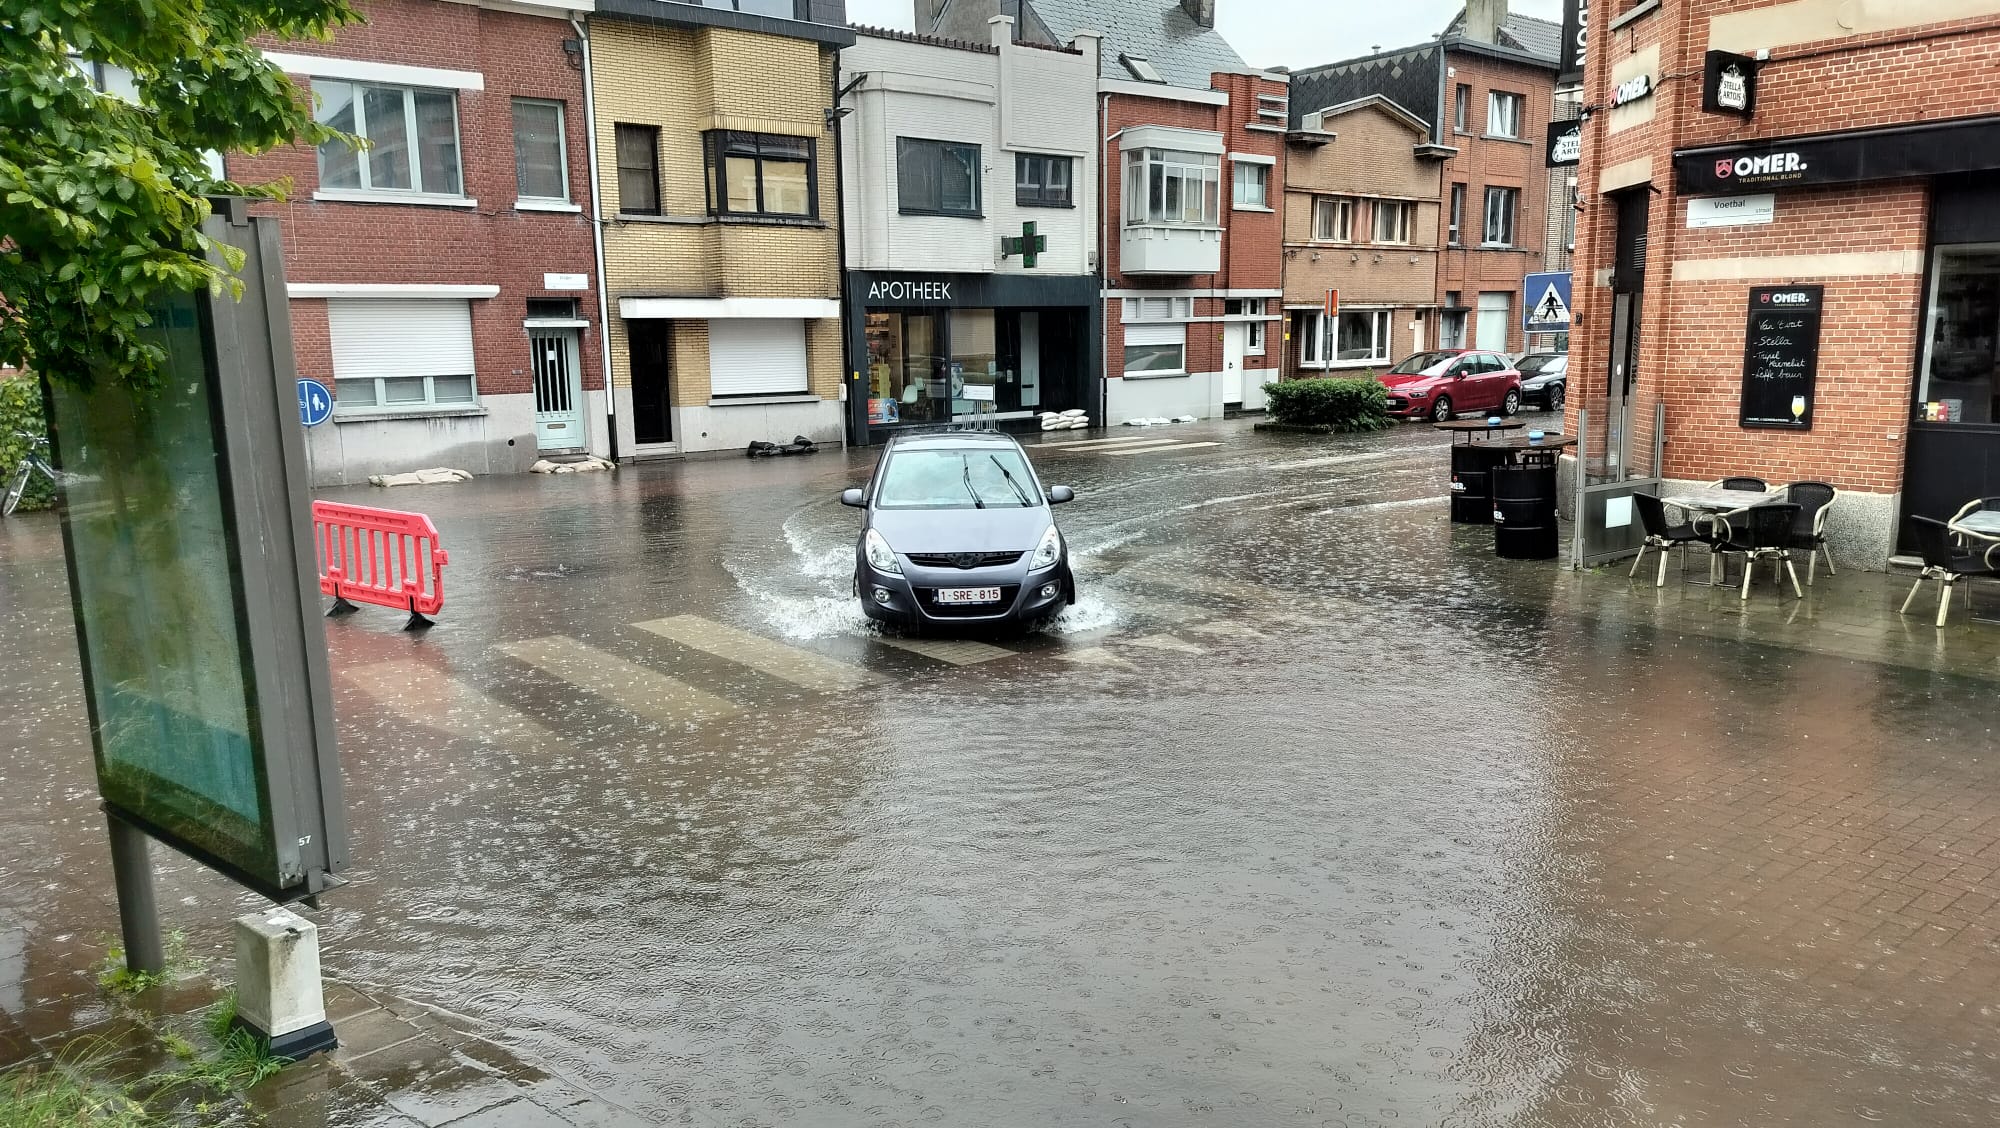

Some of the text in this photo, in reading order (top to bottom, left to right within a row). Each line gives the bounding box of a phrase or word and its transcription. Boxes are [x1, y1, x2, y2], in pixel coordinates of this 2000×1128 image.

[1723, 80, 1741, 91] STELLA
[1723, 90, 1741, 102] ARTOIS
[1561, 140, 1580, 148] STEL
[1739, 172, 1802, 184] TRADITIONAL BLOND
[1714, 200, 1746, 209] Voetbal
[868, 281, 952, 300] APOTHEEK
[941, 589, 999, 600] 1-SRE-815
[298, 835, 312, 846] 57
